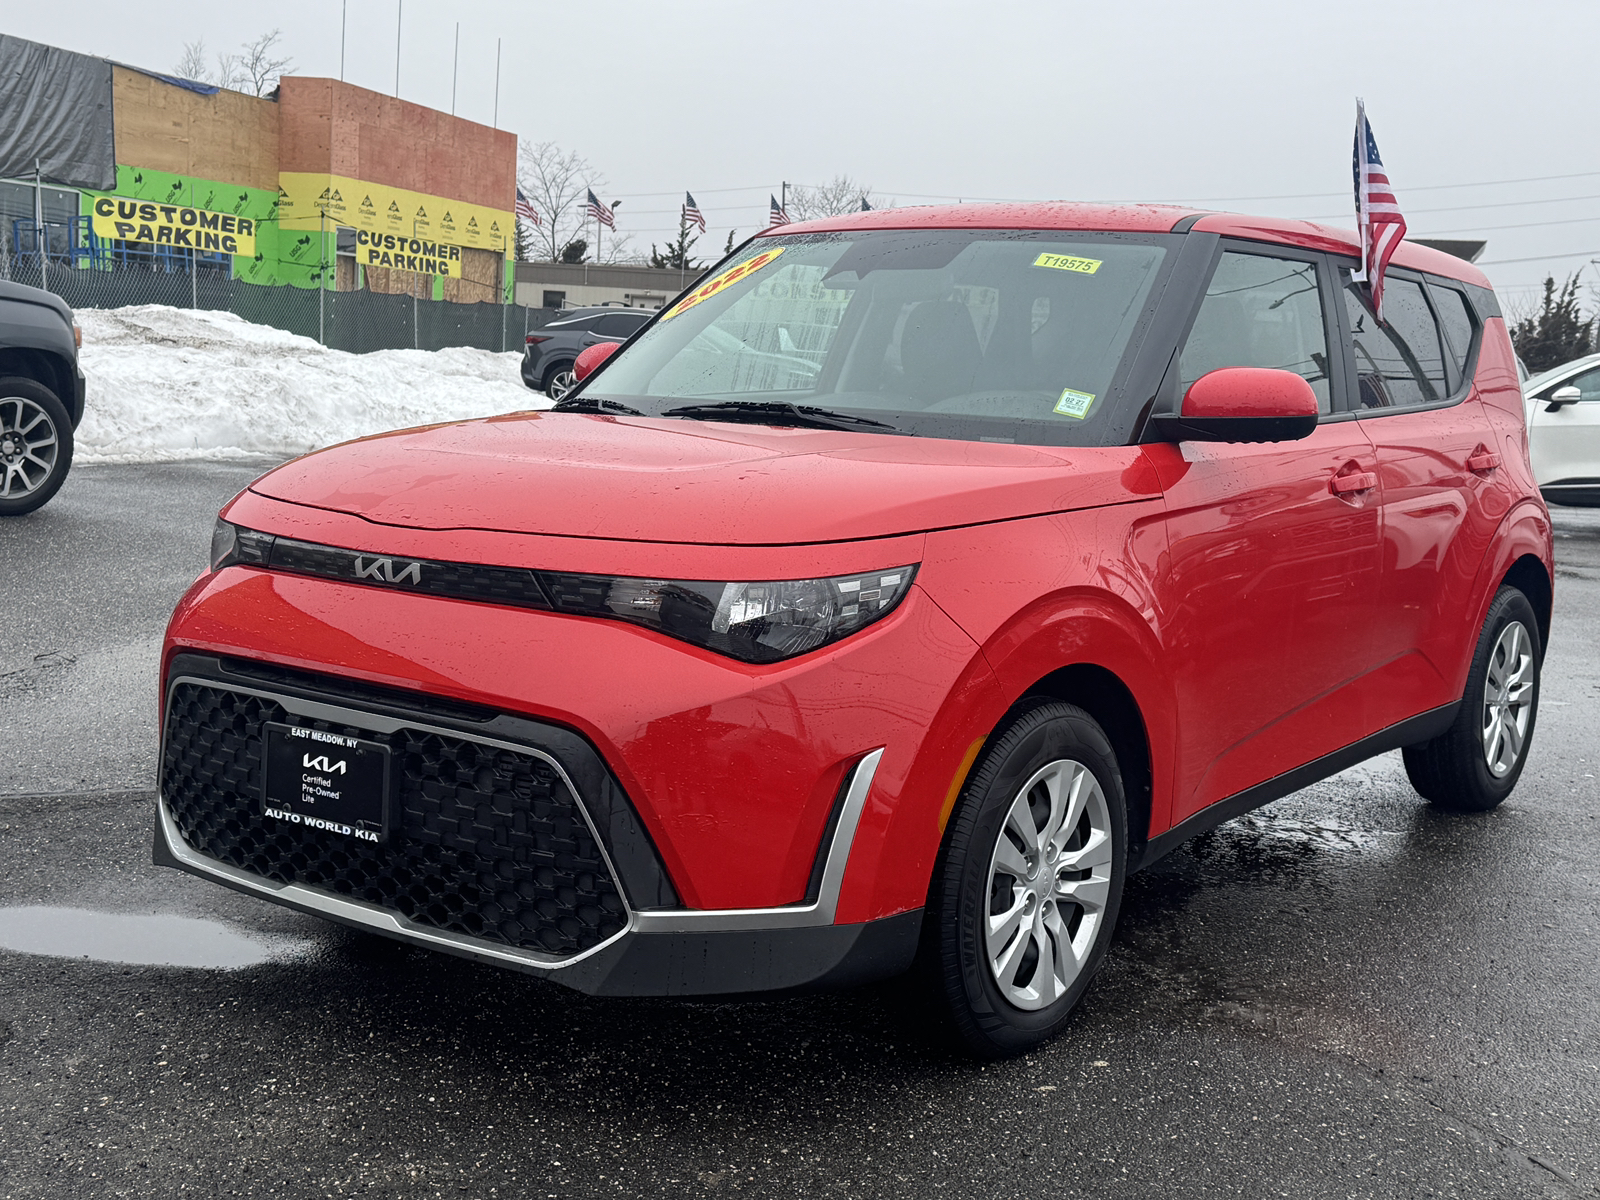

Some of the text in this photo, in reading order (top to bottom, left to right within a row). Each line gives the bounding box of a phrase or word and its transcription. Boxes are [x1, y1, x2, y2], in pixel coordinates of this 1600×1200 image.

[95, 199, 253, 237] CUSTOMER
[115, 222, 237, 253] PARKING
[357, 230, 460, 262] CUSTOMER
[289, 244, 302, 258] USG
[368, 249, 449, 275] PARKING
[1043, 255, 1094, 271] T19575
[675, 253, 771, 315] 2022
[354, 555, 421, 585] KIA
[291, 727, 310, 739] EAST
[346, 738, 358, 748] NY
[303, 753, 347, 775] KIA
[302, 773, 332, 788] Certified
[302, 793, 315, 804] Lite
[265, 808, 301, 823] AUTO
[304, 816, 351, 836] WORLD
[355, 828, 379, 843] KIA
